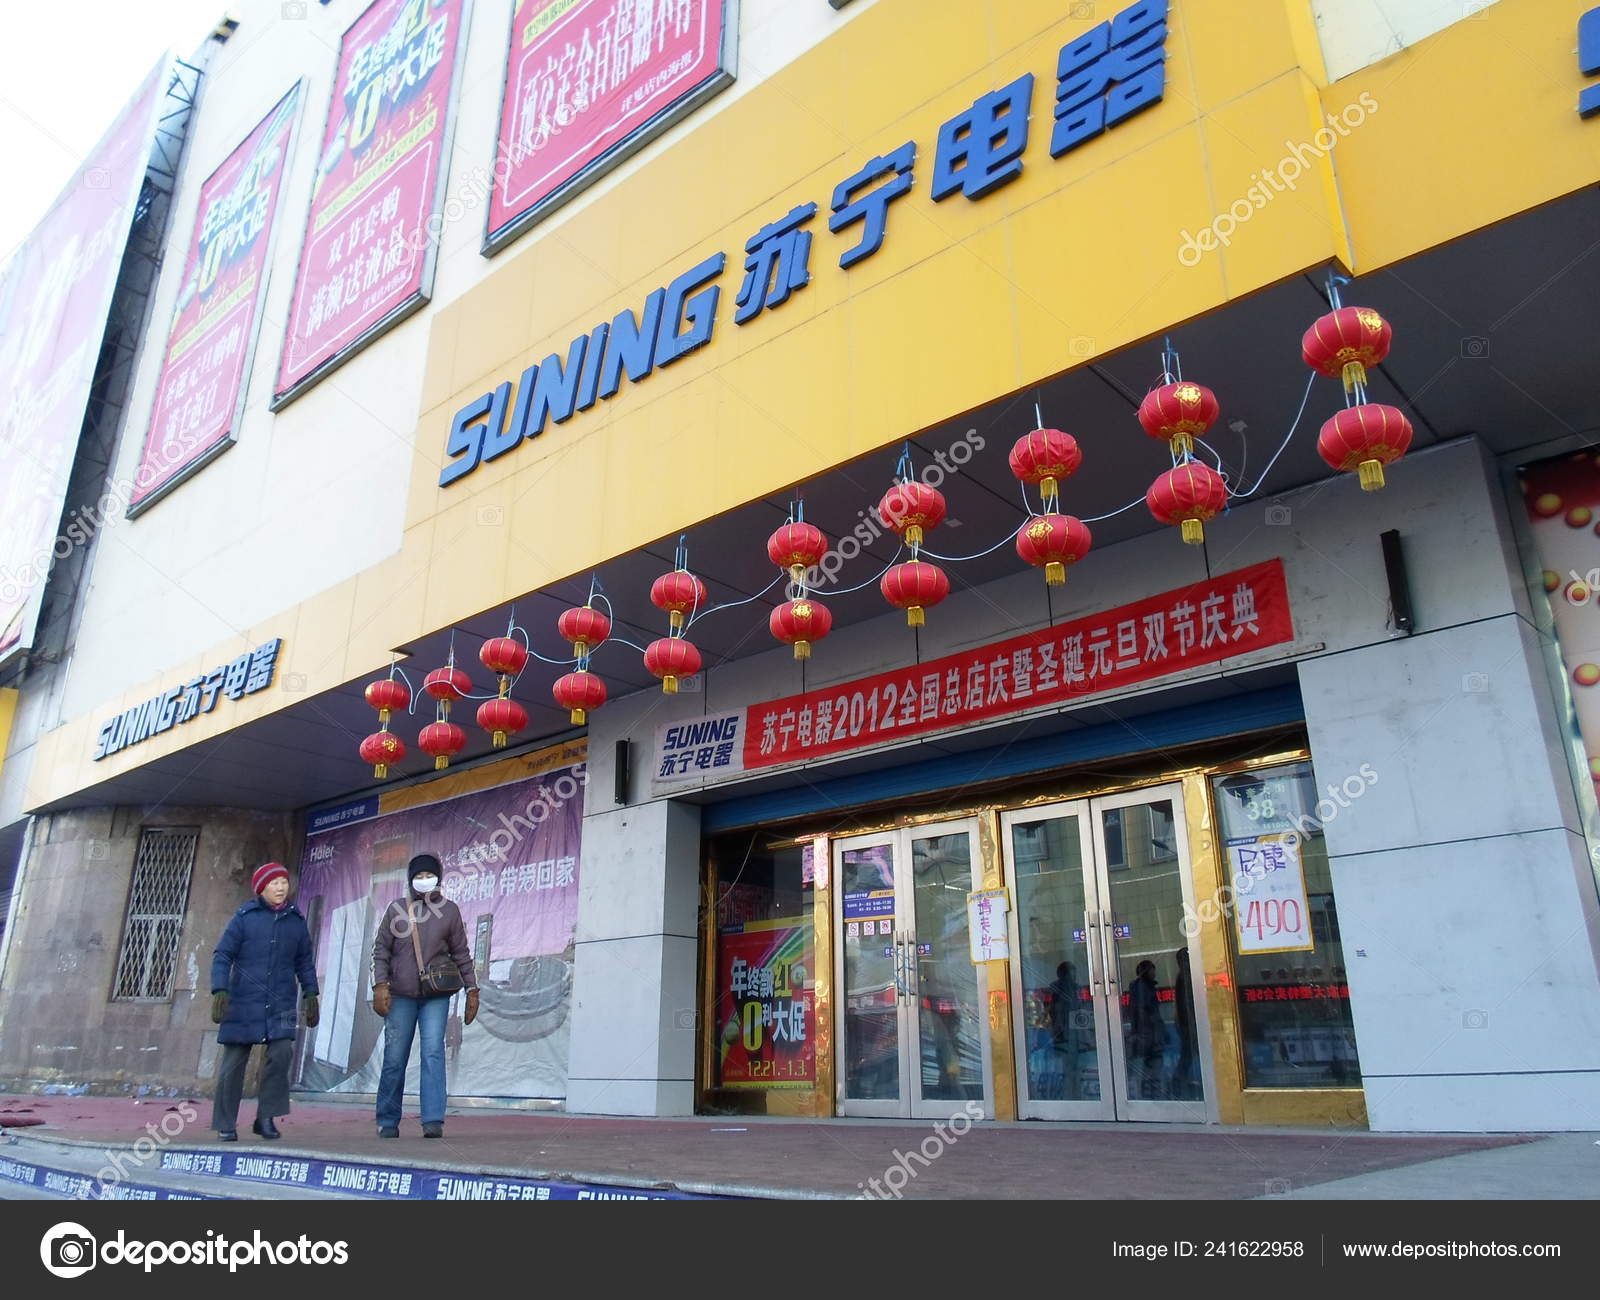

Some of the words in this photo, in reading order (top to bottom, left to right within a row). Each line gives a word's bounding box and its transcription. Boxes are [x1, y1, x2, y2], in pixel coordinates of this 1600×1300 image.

[439, 251, 727, 488] SUNING
[734, 0, 1171, 326] 苏宁电器
[760, 583, 1260, 756] 苏宁电器2012全国总店庆暨圣诞元旦双节庆典
[93, 684, 184, 762] SUNING
[177, 638, 282, 724] 苏宁电器
[663, 715, 740, 751] SUNING
[659, 741, 735, 777] 苏宁电器
[1247, 799, 1275, 820] 38
[310, 845, 335, 862] Haier
[500, 856, 576, 897] 带爱回家
[1245, 898, 1302, 941] 490
[730, 958, 793, 1000] 年终飘红
[743, 1001, 807, 1051] 0利大促
[162, 1153, 192, 1171] SUNING
[192, 1154, 223, 1174] 苏宁电器
[235, 1157, 273, 1179] SUNING
[272, 1161, 310, 1184] 苏宁电器
[322, 1166, 368, 1190] SUNING
[367, 1171, 413, 1196] 苏宁电器
[437, 1178, 493, 1200] SUNING
